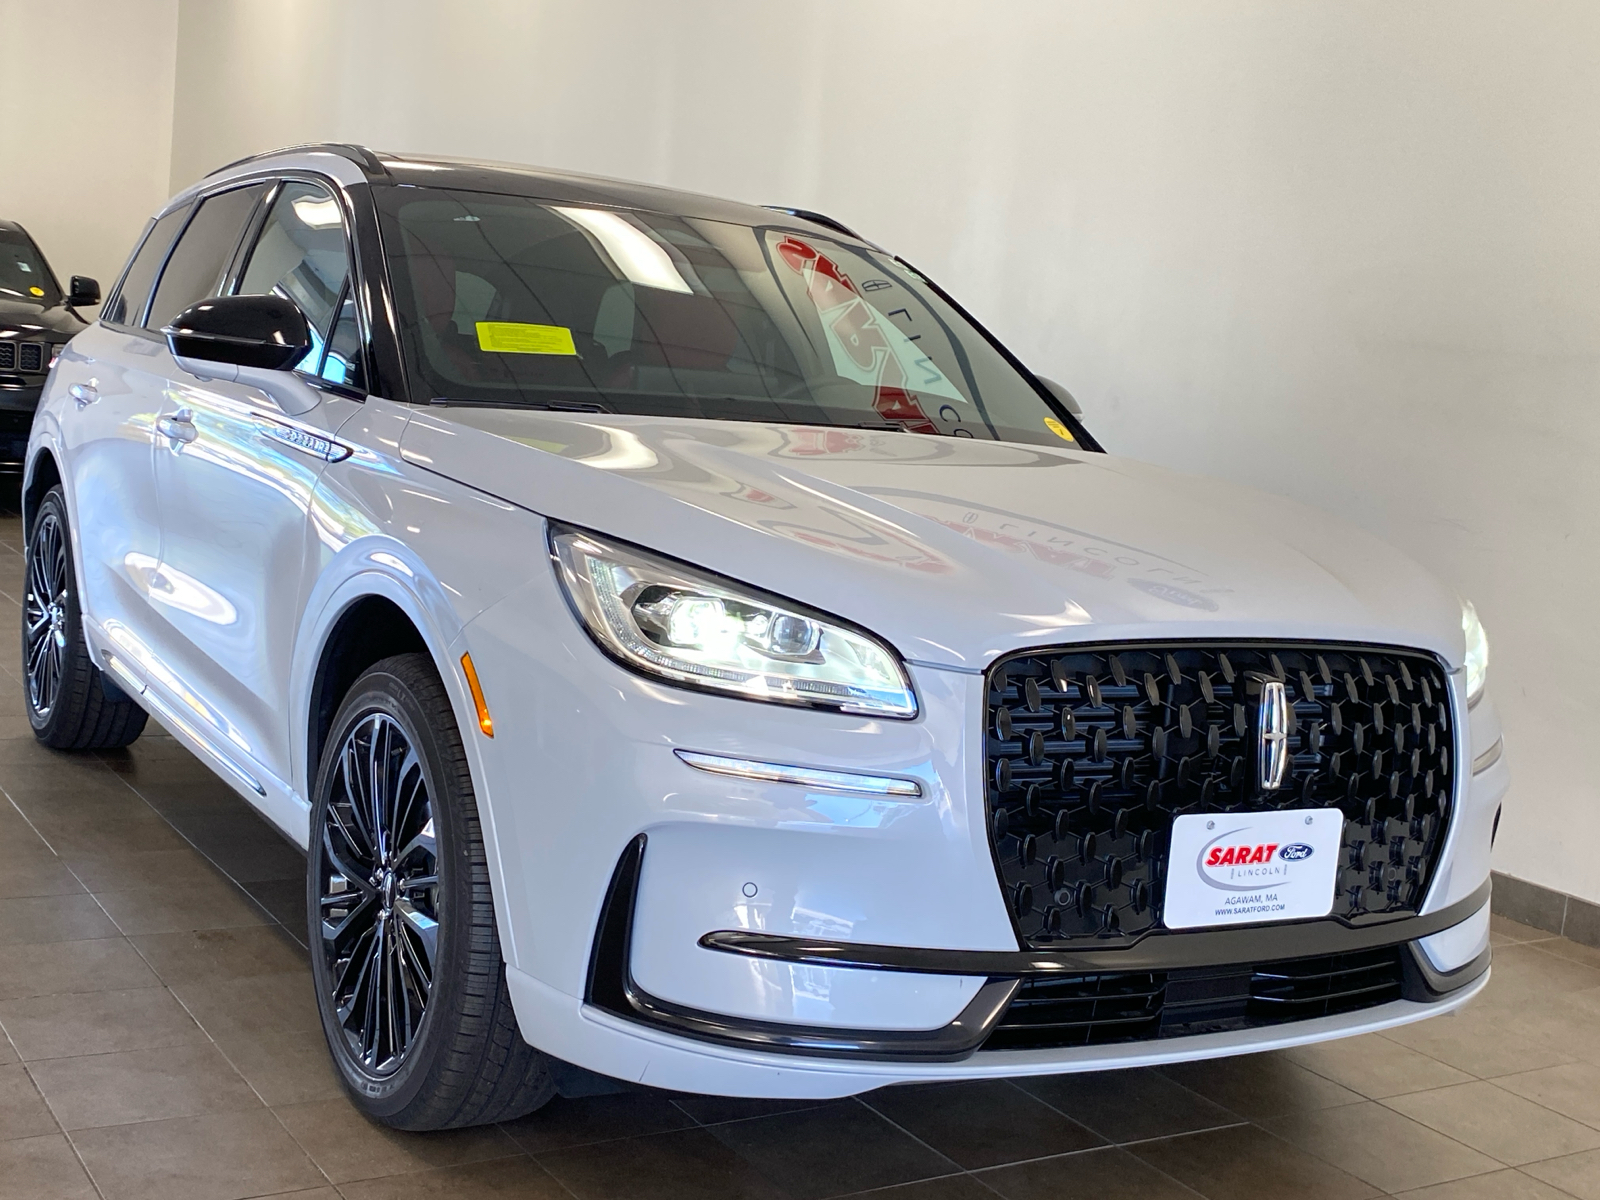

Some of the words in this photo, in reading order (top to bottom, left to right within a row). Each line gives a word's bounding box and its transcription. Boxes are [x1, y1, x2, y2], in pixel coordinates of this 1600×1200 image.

[1206, 844, 1279, 866] SARAT
[1282, 844, 1309, 860] Ford
[1238, 867, 1280, 877] LINCOLN
[1224, 894, 1264, 905] AGAWAM,
[1265, 893, 1278, 902] MA
[1215, 904, 1285, 915] WWW.SARATFORD.COM
